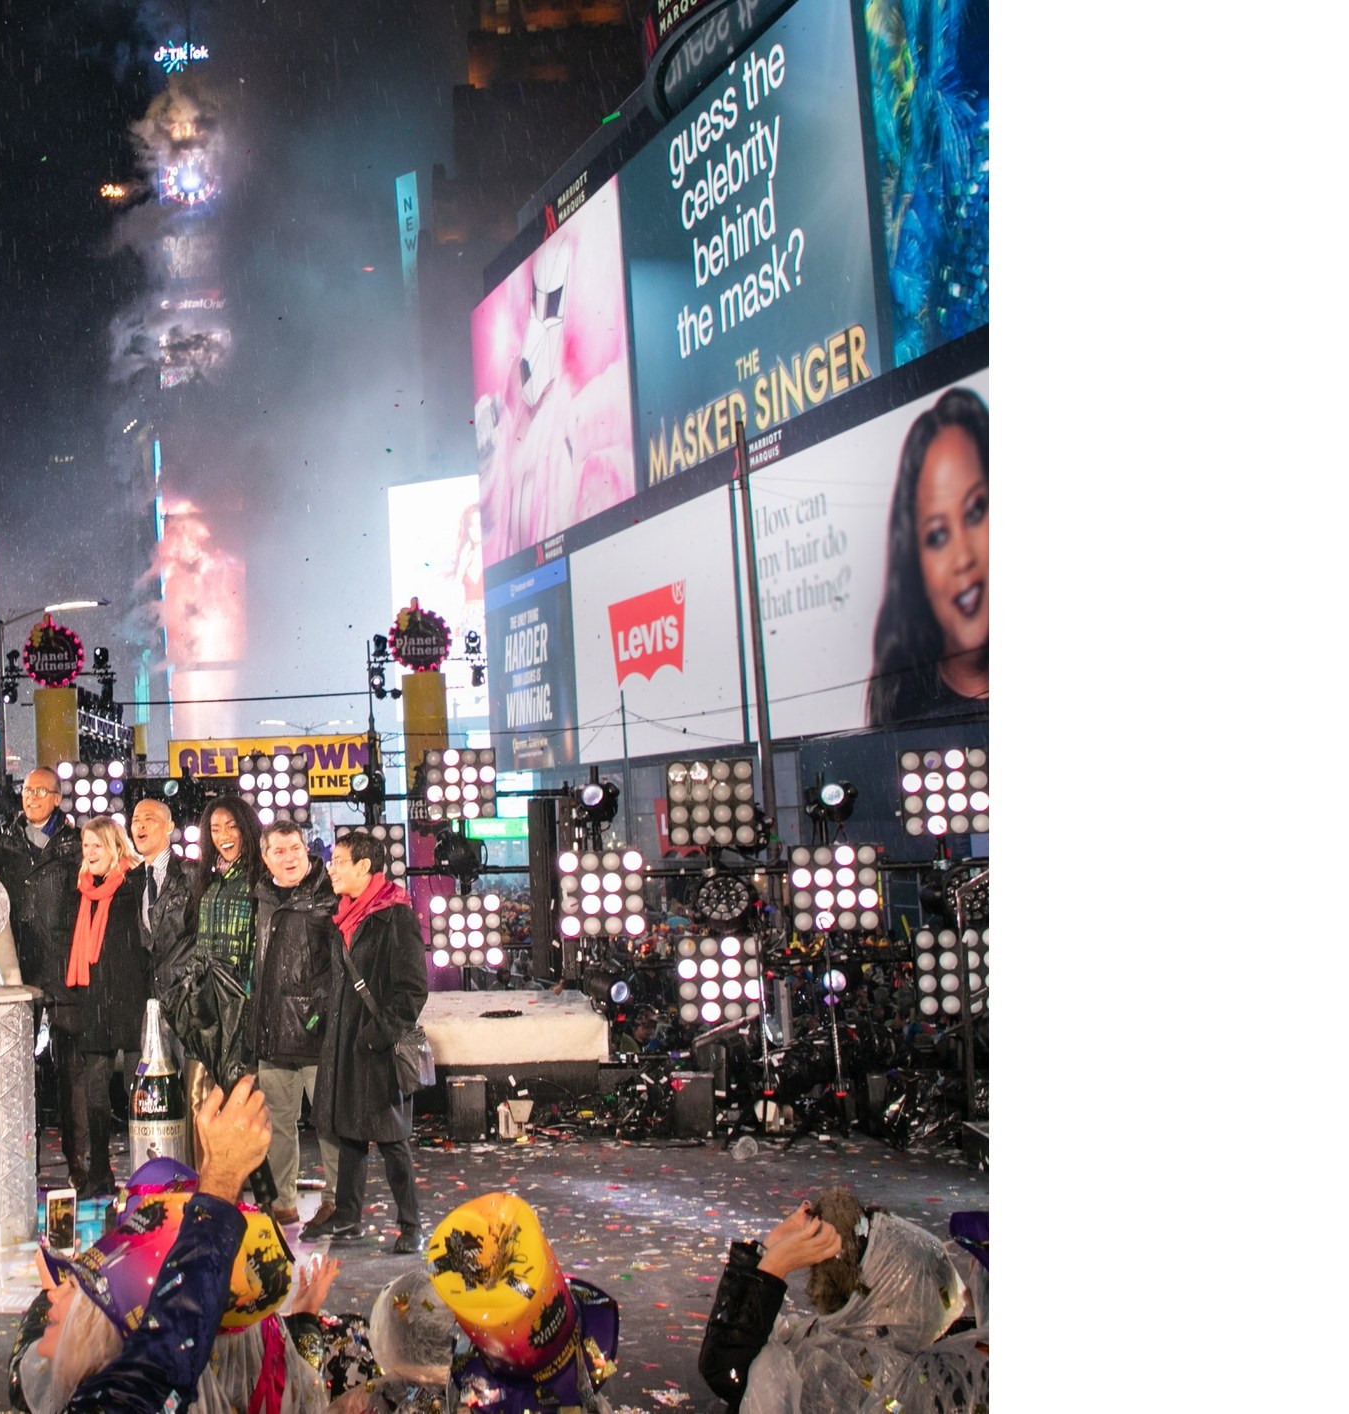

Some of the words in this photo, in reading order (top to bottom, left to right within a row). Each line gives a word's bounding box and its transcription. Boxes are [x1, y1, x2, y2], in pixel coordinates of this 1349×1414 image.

[669, 86, 738, 189] guess
[742, 43, 786, 111] the
[557, 170, 588, 209] MARRIOTT
[681, 115, 780, 231] celebrity
[558, 190, 586, 224] MARQUIS
[692, 178, 776, 288] behind
[677, 304, 713, 360] the
[720, 227, 805, 334] mask?
[735, 347, 760, 383] THE
[648, 389, 748, 489] MASKED
[753, 323, 875, 432] SINGER
[755, 505, 790, 540] How
[796, 492, 827, 524] can
[758, 552, 781, 585] my
[785, 531, 820, 572] hair
[822, 523, 848, 560] do
[760, 588, 793, 621] that
[795, 565, 852, 612] thing?
[29, 651, 69, 665] planet
[34, 661, 77, 672] fitness
[395, 635, 437, 649] planet
[401, 646, 446, 656] fitness
[505, 622, 548, 674] HARDER
